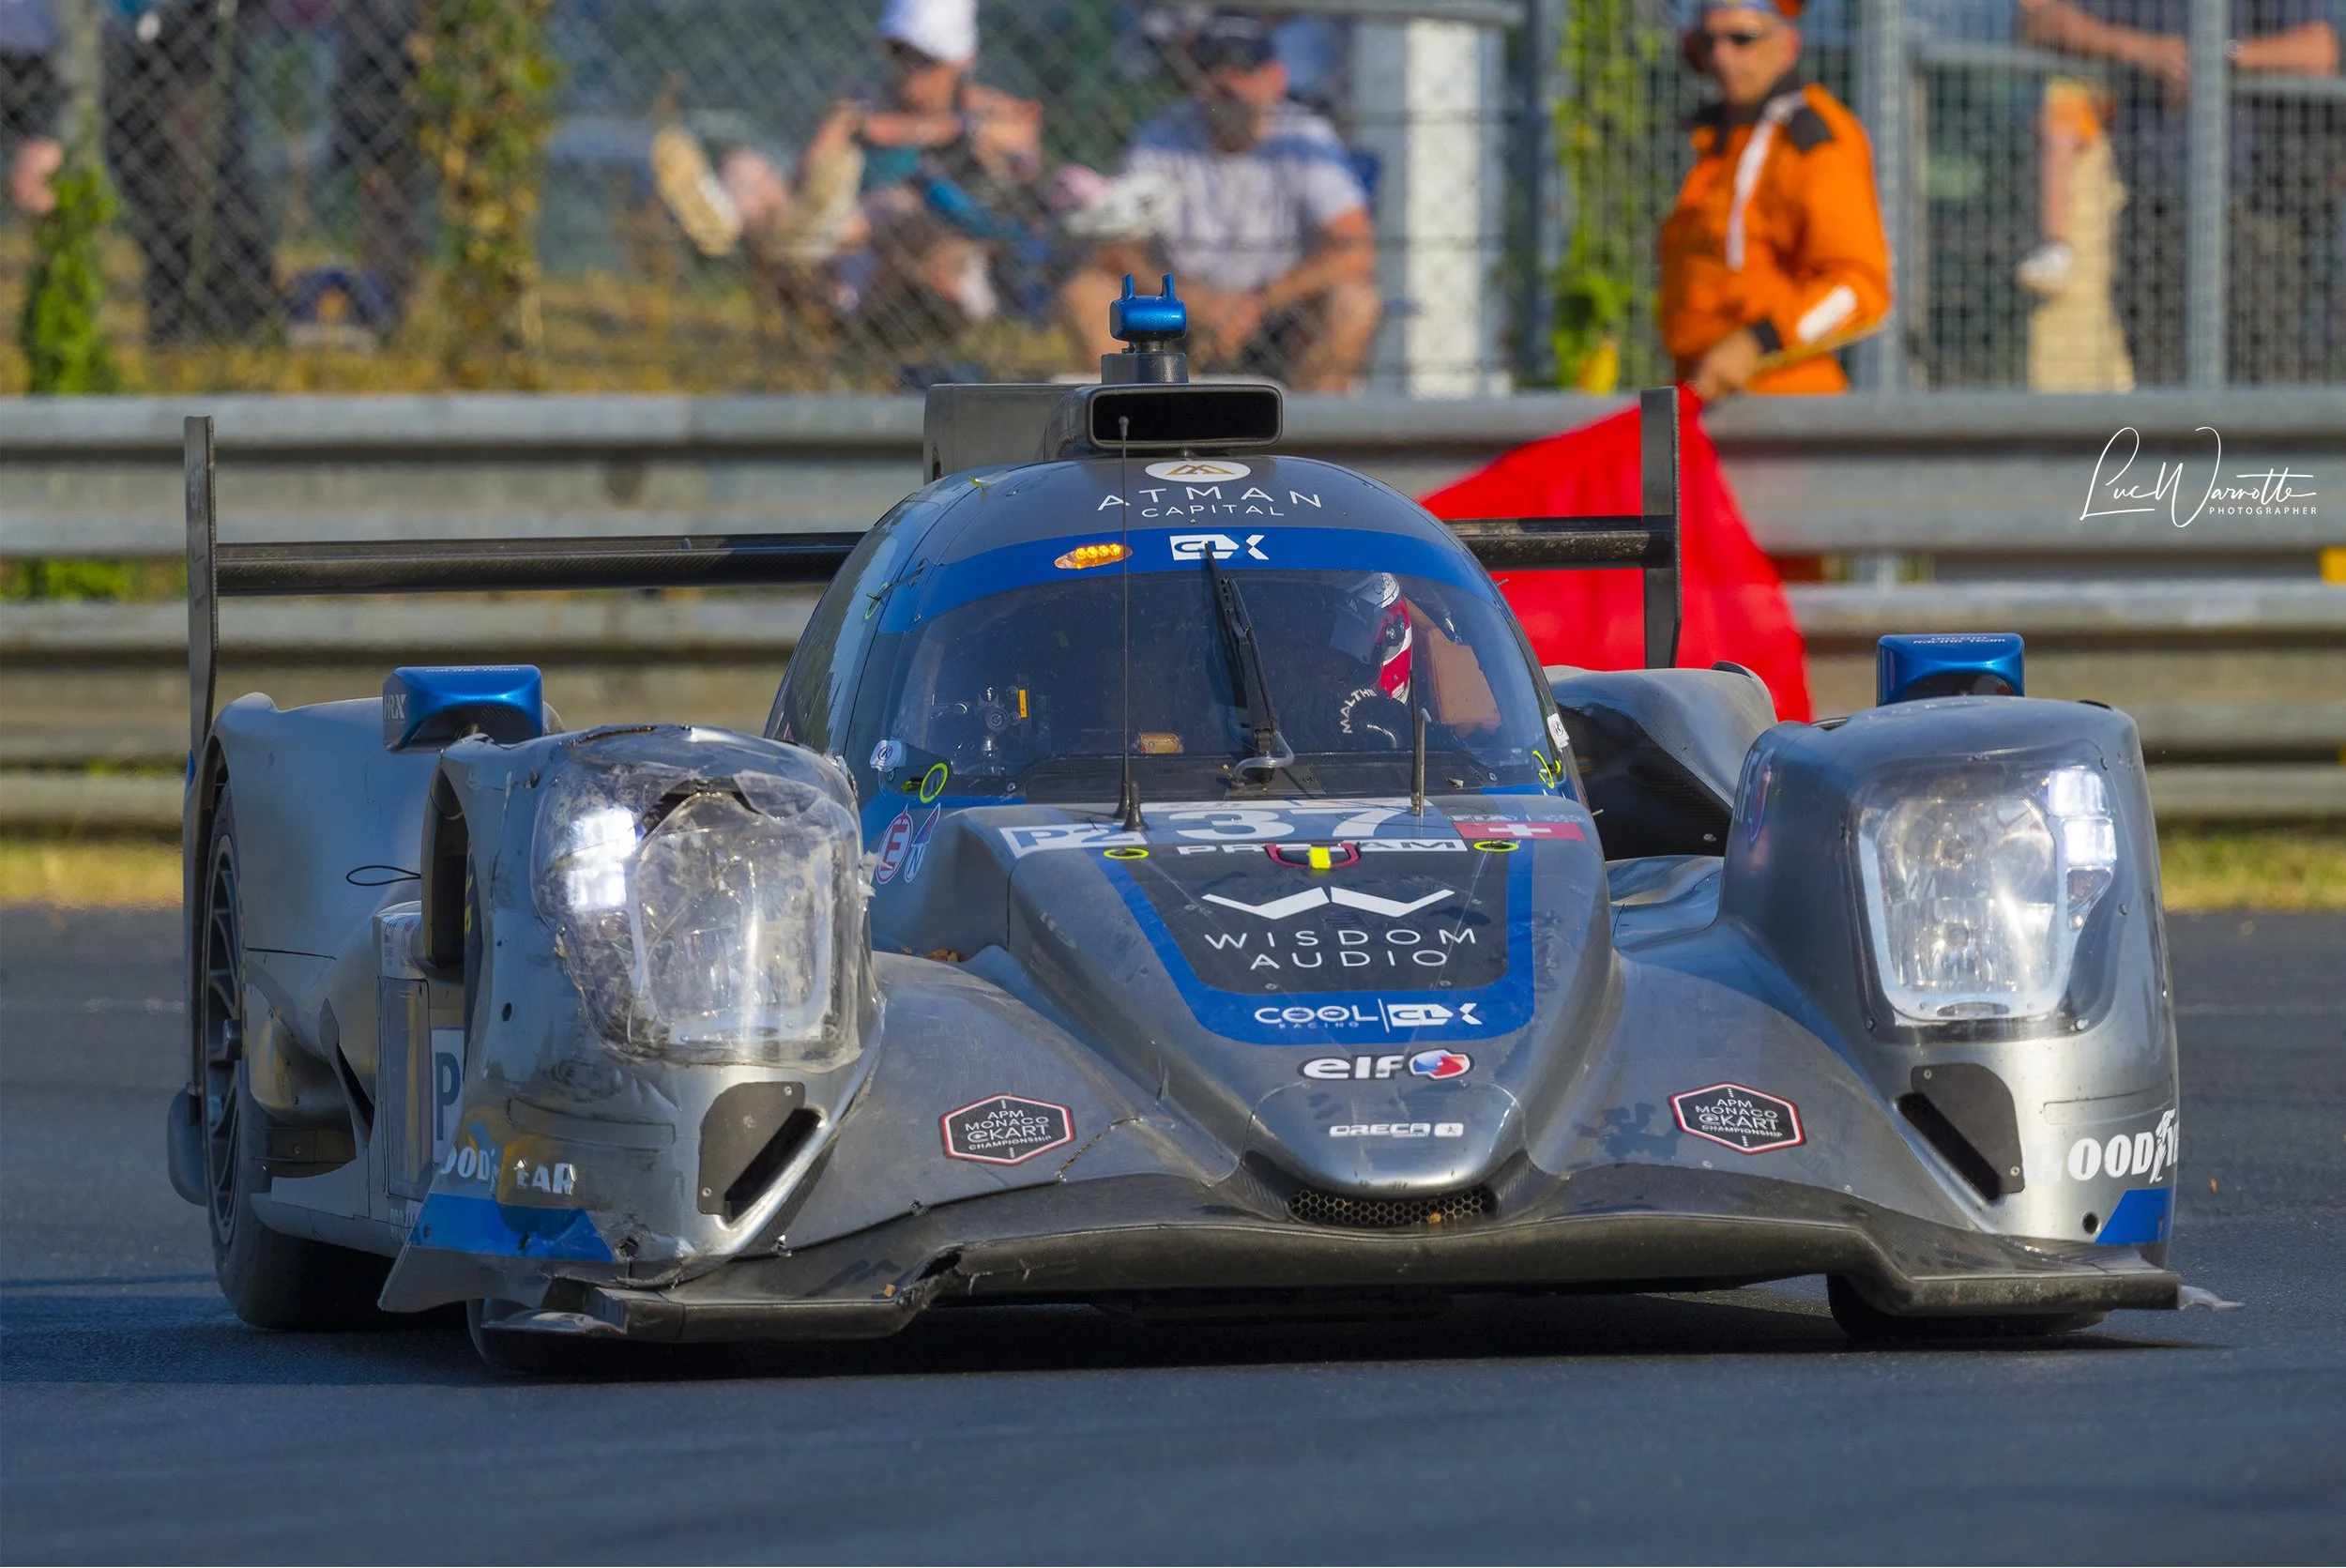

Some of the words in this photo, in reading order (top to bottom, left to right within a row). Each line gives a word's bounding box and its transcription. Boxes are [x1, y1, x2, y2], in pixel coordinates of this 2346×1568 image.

[1097, 485, 1322, 512] ATMAN
[1141, 503, 1285, 518] CAPITAL
[1168, 807, 1409, 841] 37
[1203, 927, 1477, 951] WISDOM
[1249, 950, 1449, 971] AUDIO
[1254, 1004, 1379, 1025] COOL
[1278, 1021, 1360, 1029] RACING
[1302, 1055, 1406, 1080] elf
[1695, 1104, 1778, 1119] MONACO
[1716, 1098, 1754, 1109] APM
[987, 1109, 1025, 1120] APM
[965, 1116, 1050, 1132] MONACO
[1329, 1122, 1431, 1137] ORECA
[1700, 1124, 1784, 1138] CHAMPIONSHIP
[968, 1134, 1053, 1151] CHAMPIONSHIP
